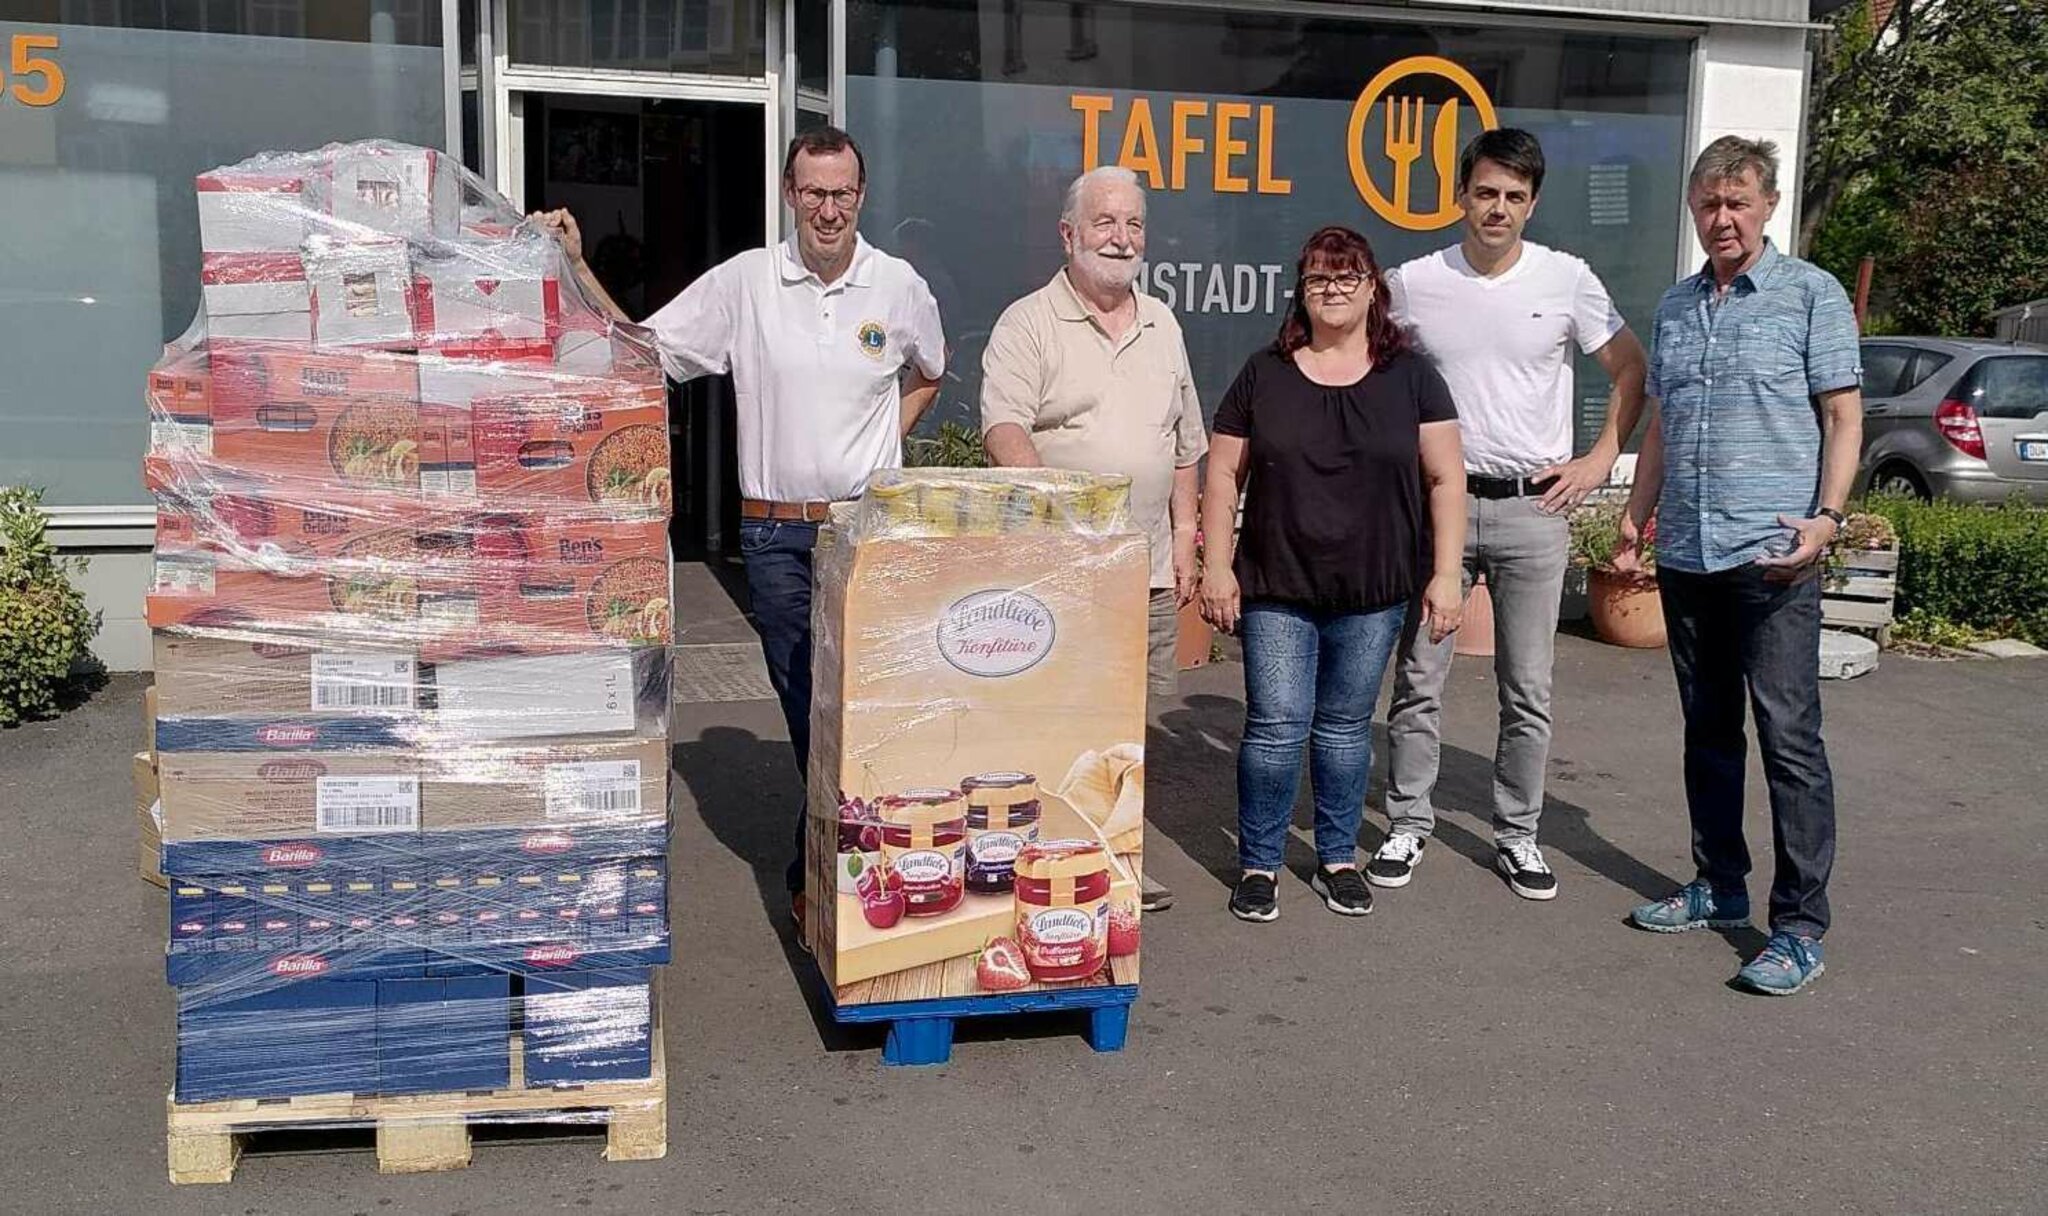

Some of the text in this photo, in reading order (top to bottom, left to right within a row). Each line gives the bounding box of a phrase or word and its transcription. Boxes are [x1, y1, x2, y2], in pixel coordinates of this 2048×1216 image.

[0, 34, 66, 107] 5
[1071, 95, 1292, 194] TAFEL
[559, 536, 603, 553] Ben's
[955, 636, 1036, 659] Konfitüre
[266, 729, 315, 741] Barilla
[270, 849, 317, 861] Barilla
[1036, 914, 1088, 932] Landliebe
[277, 959, 322, 972] Barilla
